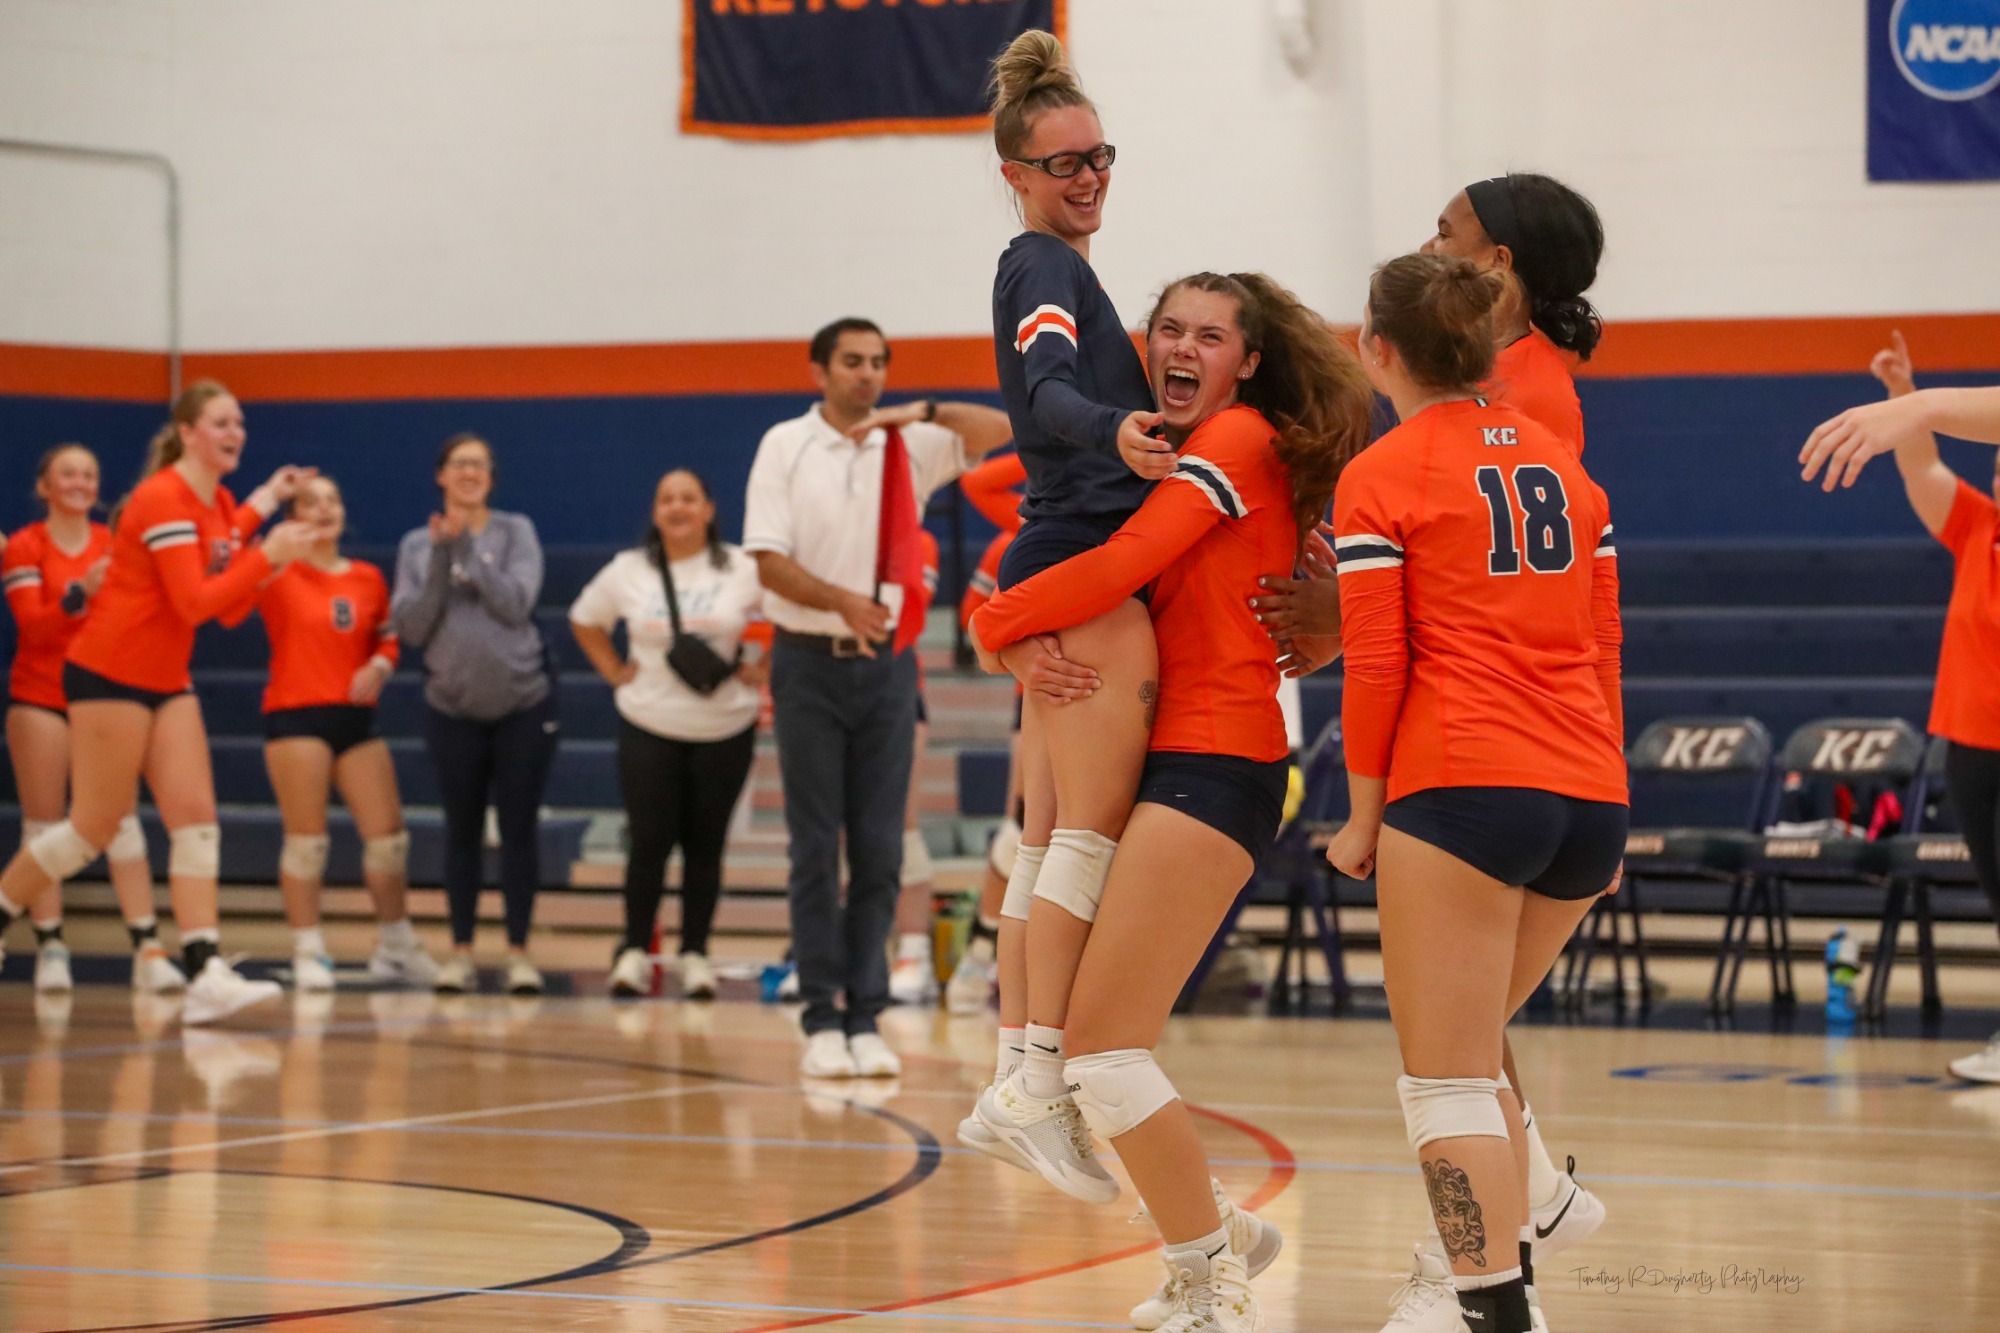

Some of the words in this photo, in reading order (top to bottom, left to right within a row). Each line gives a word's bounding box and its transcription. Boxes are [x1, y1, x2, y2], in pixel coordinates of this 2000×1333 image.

[1481, 427, 1518, 445] KC
[1475, 464, 1574, 576] 18
[1661, 726, 1748, 769] KC
[1812, 728, 1902, 771] KC
